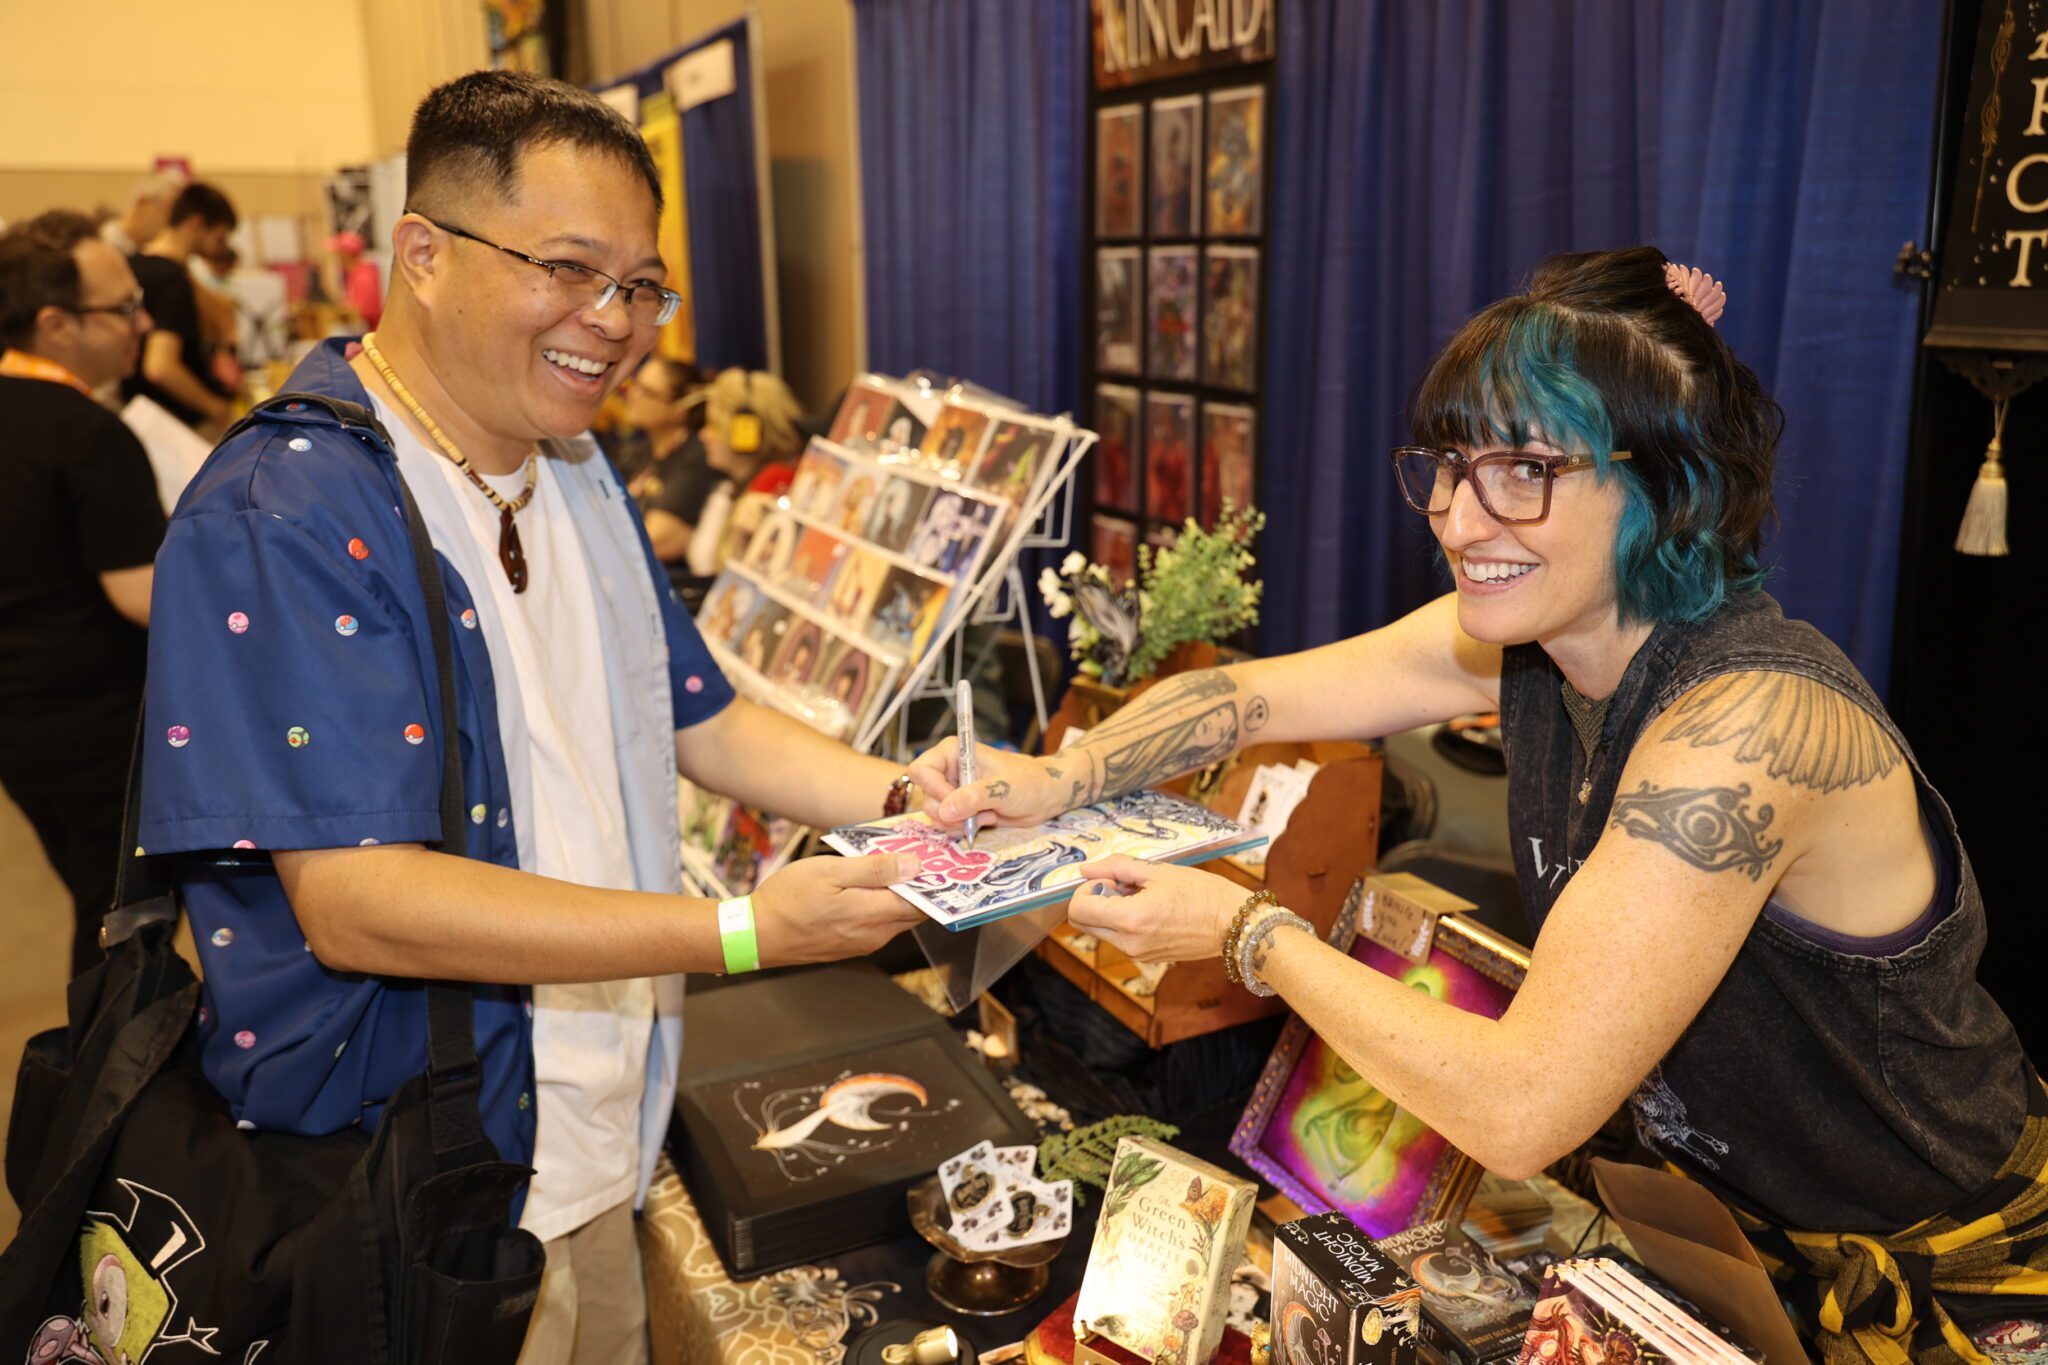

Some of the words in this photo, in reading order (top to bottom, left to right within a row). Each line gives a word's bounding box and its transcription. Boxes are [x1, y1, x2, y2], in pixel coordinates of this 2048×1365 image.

[1132, 1212, 1187, 1250] Witch's
[1139, 1196, 1187, 1231] Green
[1128, 1231, 1181, 1264] ORACLE
[1336, 1232, 1384, 1273] MAGIC
[1373, 1220, 1448, 1251] MIDNIGHT
[1391, 1234, 1445, 1258] MAGIC
[1313, 1231, 1376, 1285] MIDNIGHT
[1283, 1248, 1339, 1314] MIDNIGHT
[1289, 1272, 1330, 1322] MAGIC
